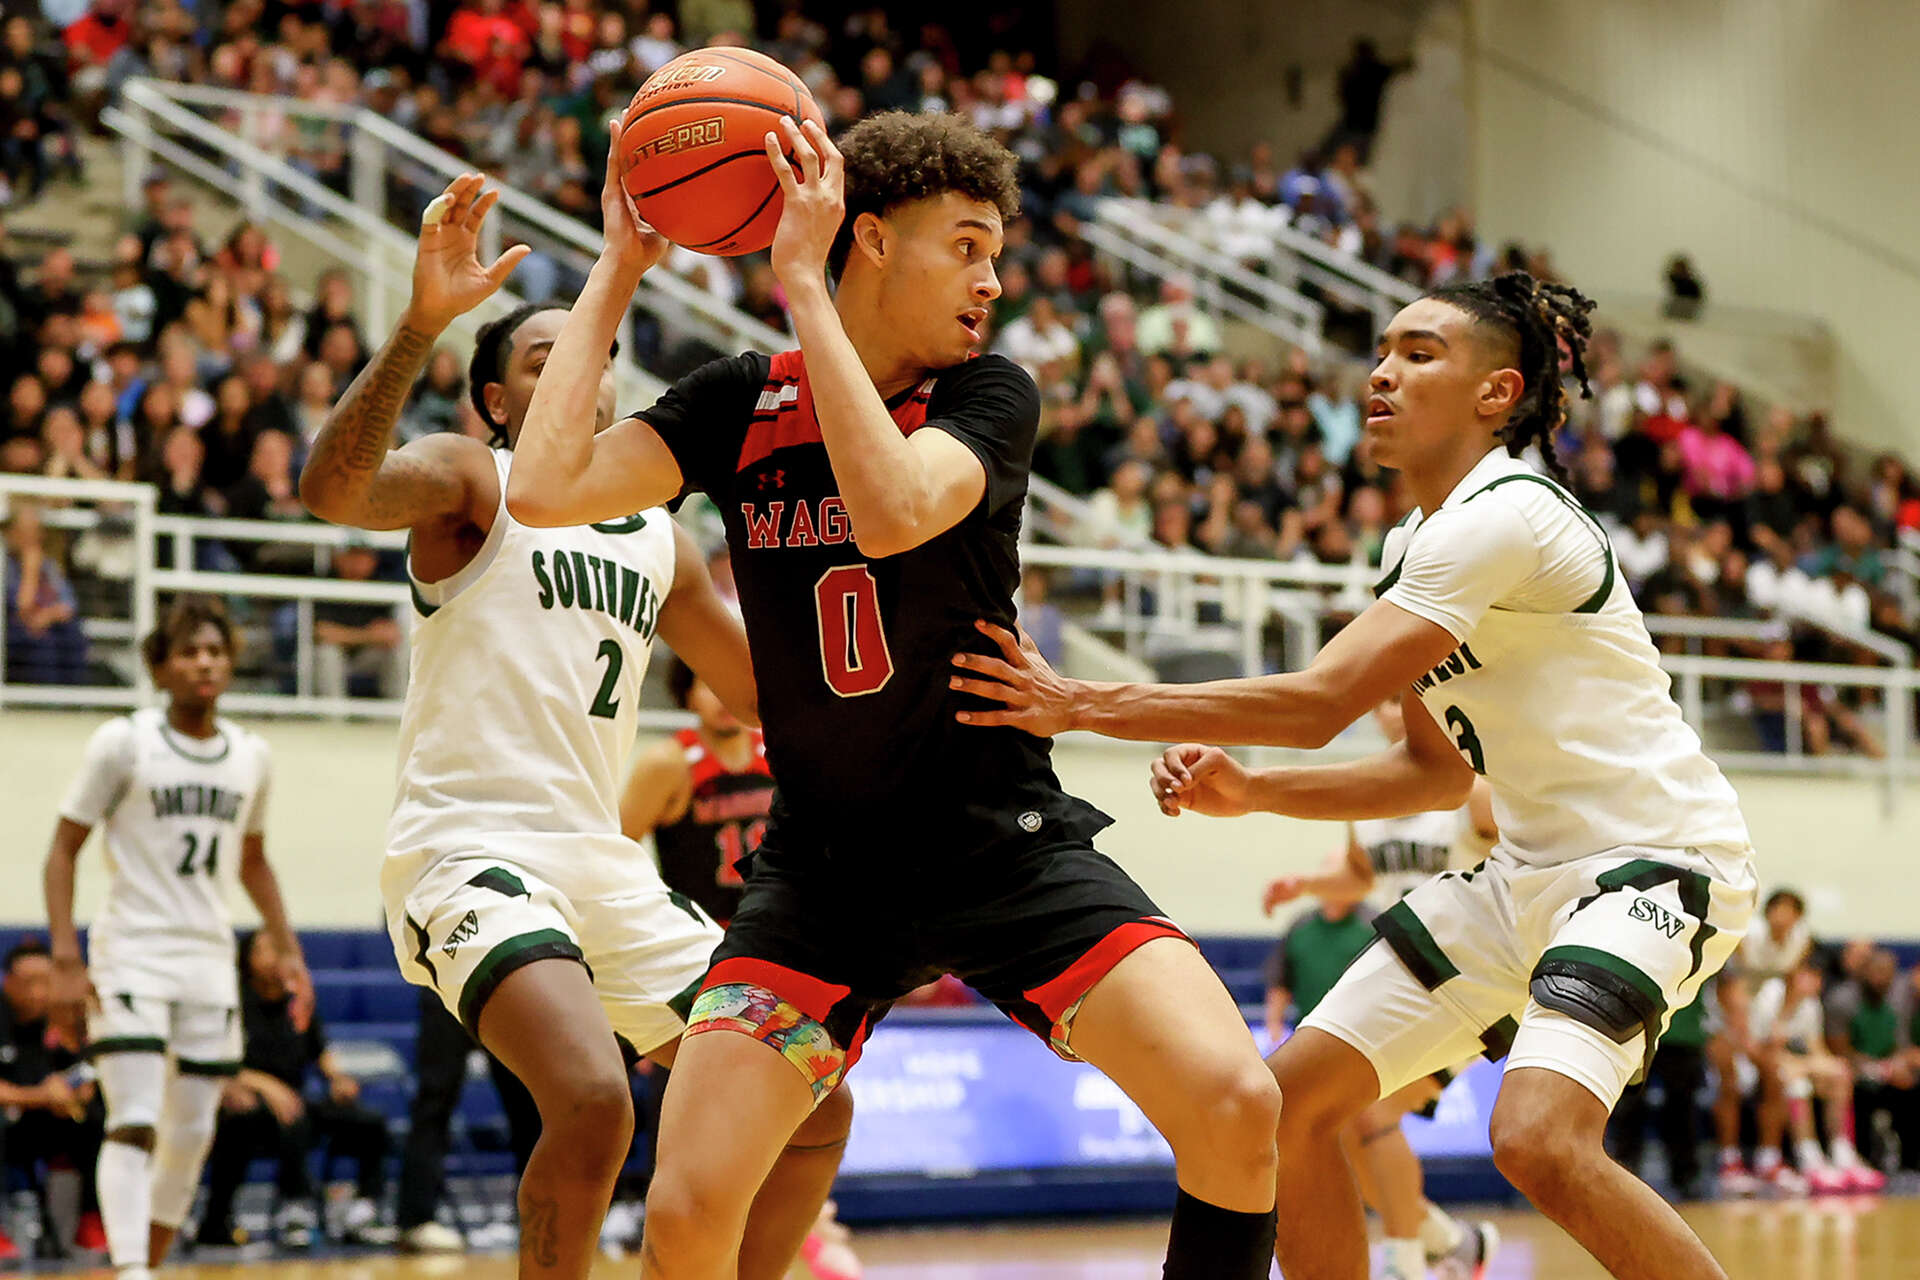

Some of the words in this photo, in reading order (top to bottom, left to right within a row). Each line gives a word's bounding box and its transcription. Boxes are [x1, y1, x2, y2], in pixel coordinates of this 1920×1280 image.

[677, 121, 721, 151] PRO
[741, 496, 857, 549] WAG
[814, 563, 895, 699] 0
[587, 638, 624, 720] 2
[1444, 704, 1487, 776] 3
[177, 832, 219, 877] 24
[442, 909, 479, 960] SW
[1628, 896, 1685, 939] SW
